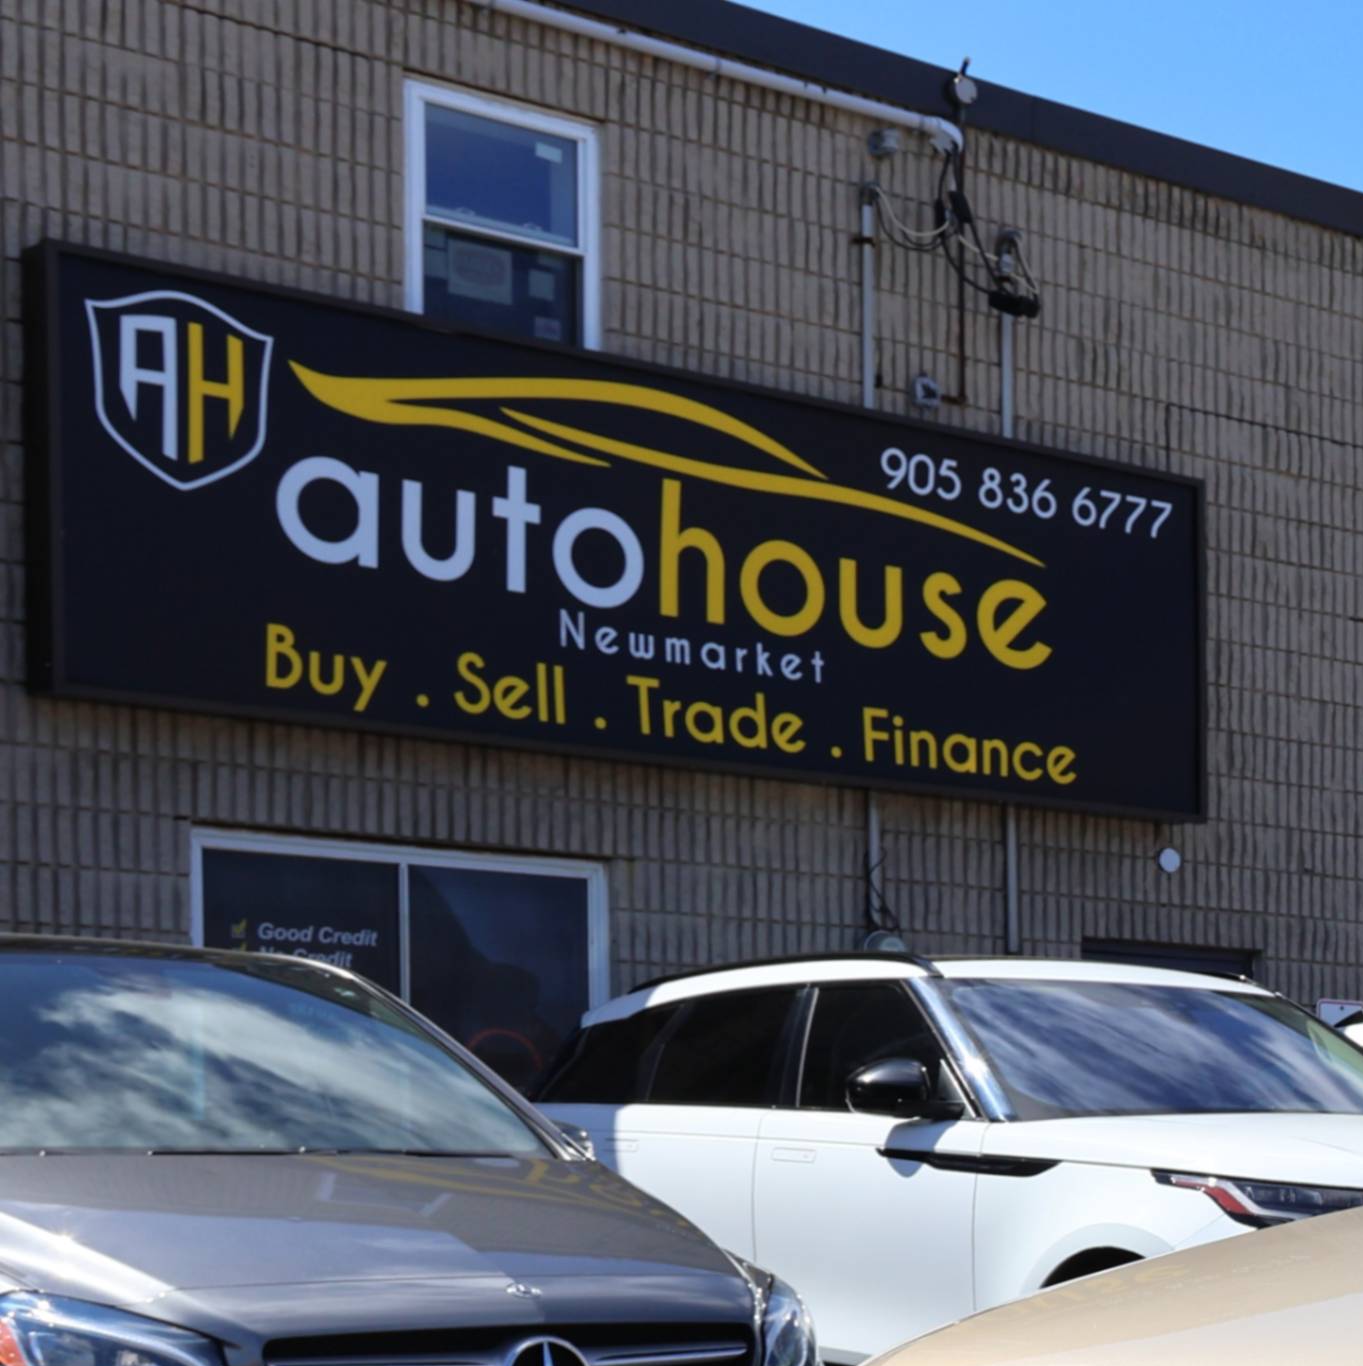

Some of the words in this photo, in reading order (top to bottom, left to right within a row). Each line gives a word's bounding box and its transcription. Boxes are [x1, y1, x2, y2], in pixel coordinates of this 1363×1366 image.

[881, 447, 962, 501] 905
[978, 467, 1058, 520] 836
[1072, 486, 1174, 539] 6777
[275, 455, 1053, 671] autohouse
[560, 608, 825, 684] Newmarket
[266, 623, 387, 712] Buy
[454, 652, 566, 725] Sell
[627, 675, 806, 753] Trade
[863, 707, 1078, 785] Finance
[257, 922, 314, 943] Good
[318, 926, 378, 947] Credit
